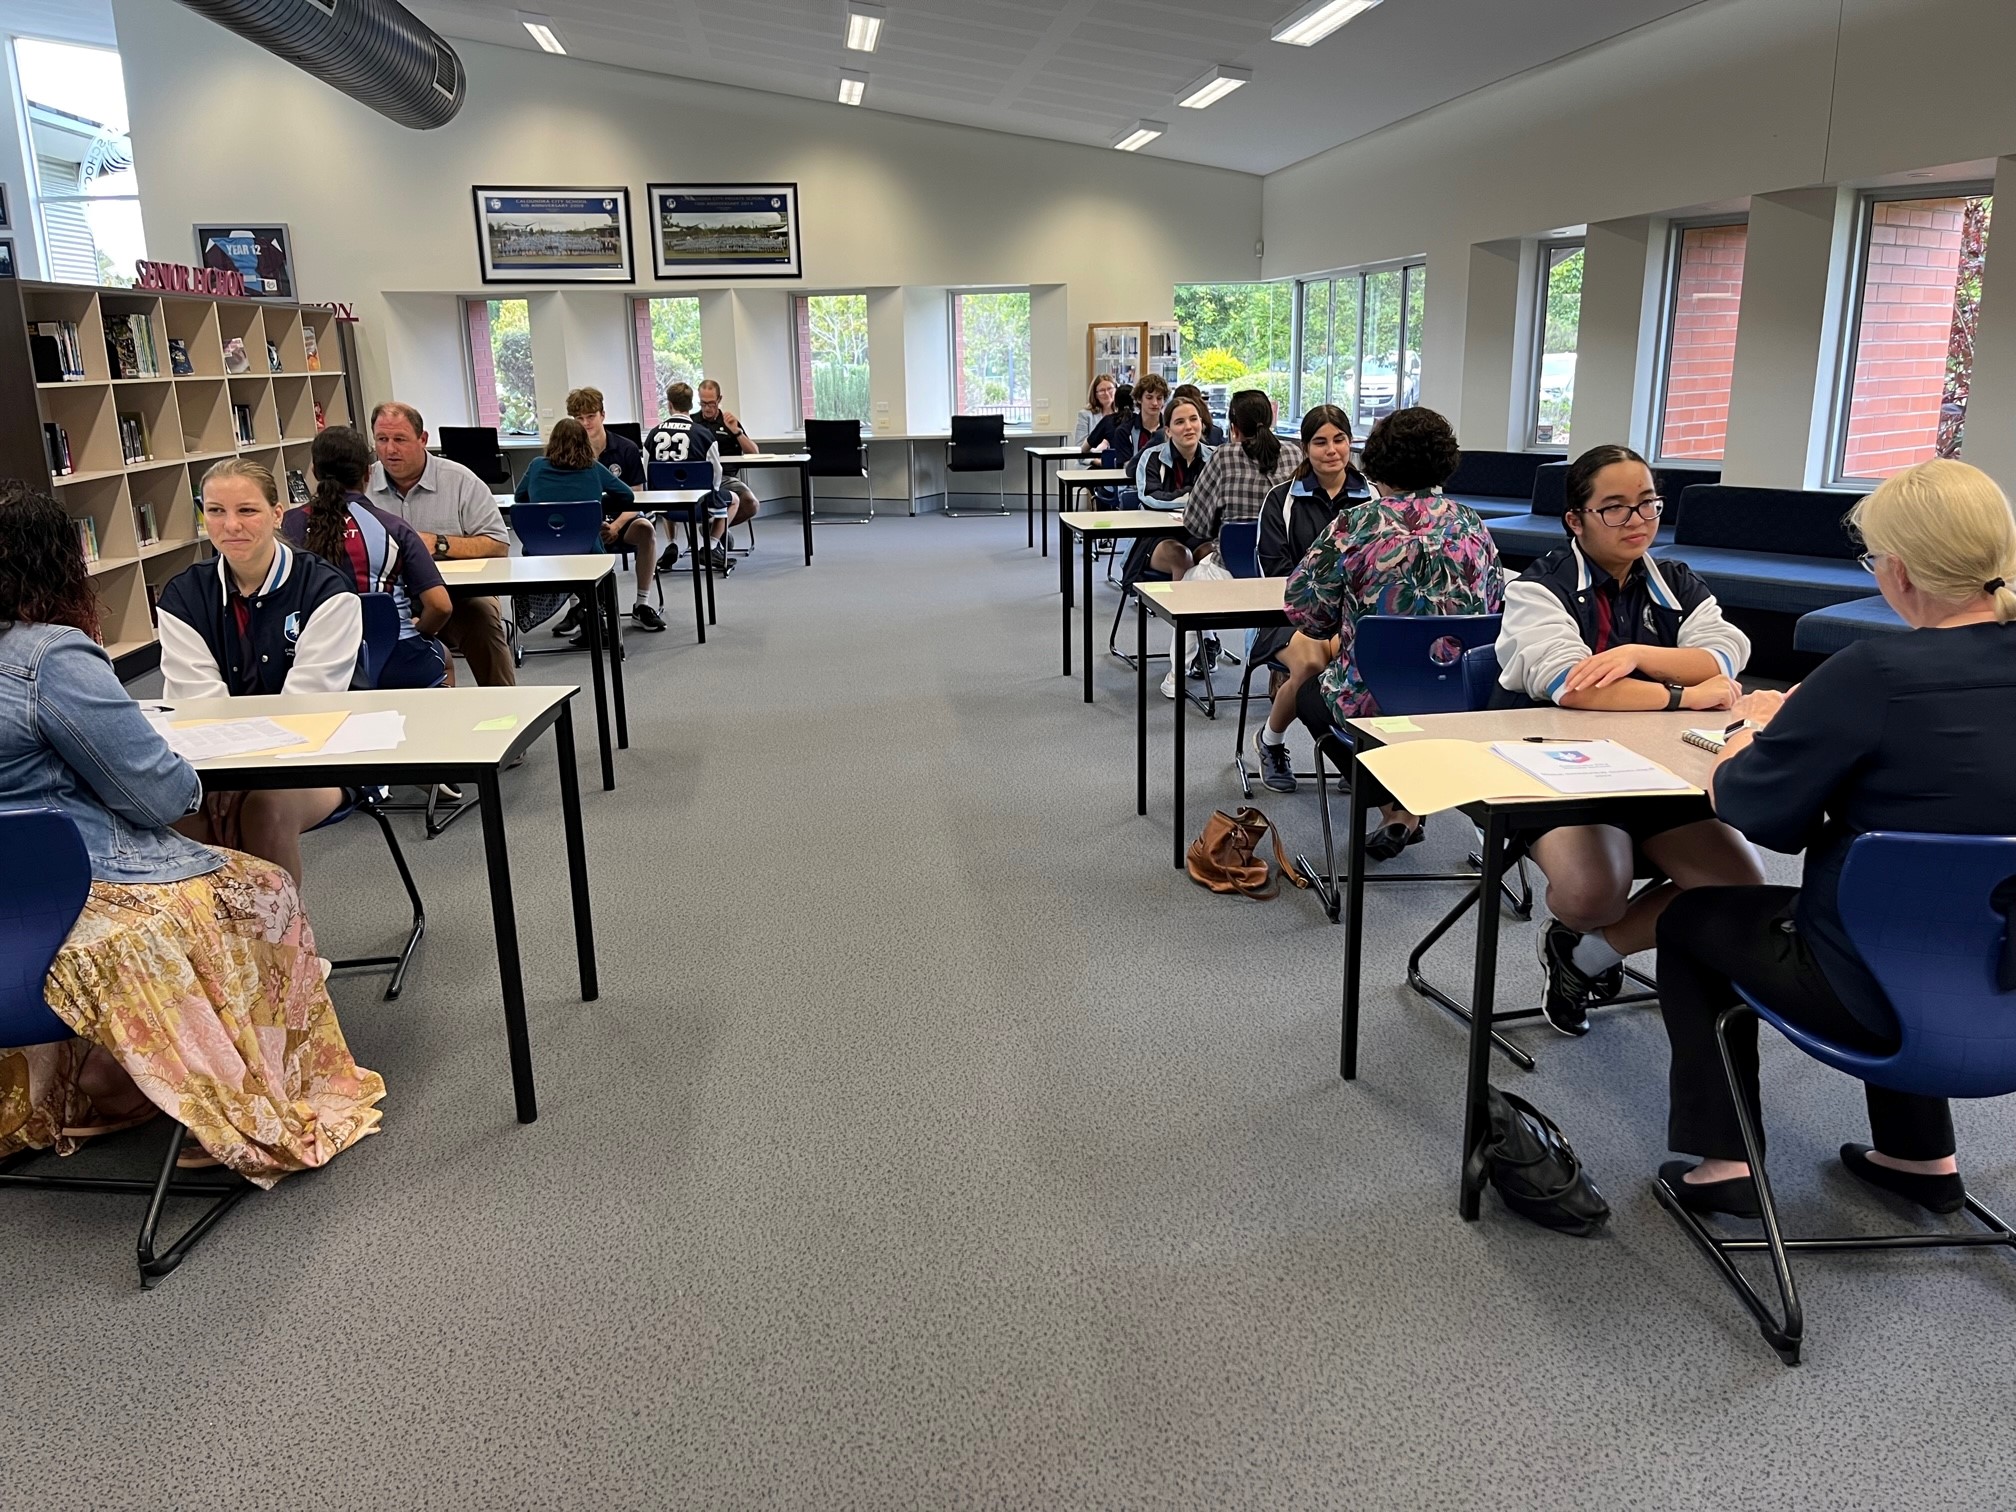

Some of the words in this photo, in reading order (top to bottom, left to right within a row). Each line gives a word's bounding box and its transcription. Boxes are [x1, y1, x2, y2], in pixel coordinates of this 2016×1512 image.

[226, 244, 250, 256] YEAR
[250, 244, 262, 255] 12
[135, 259, 190, 292] SENIOR
[653, 431, 690, 461] 23
